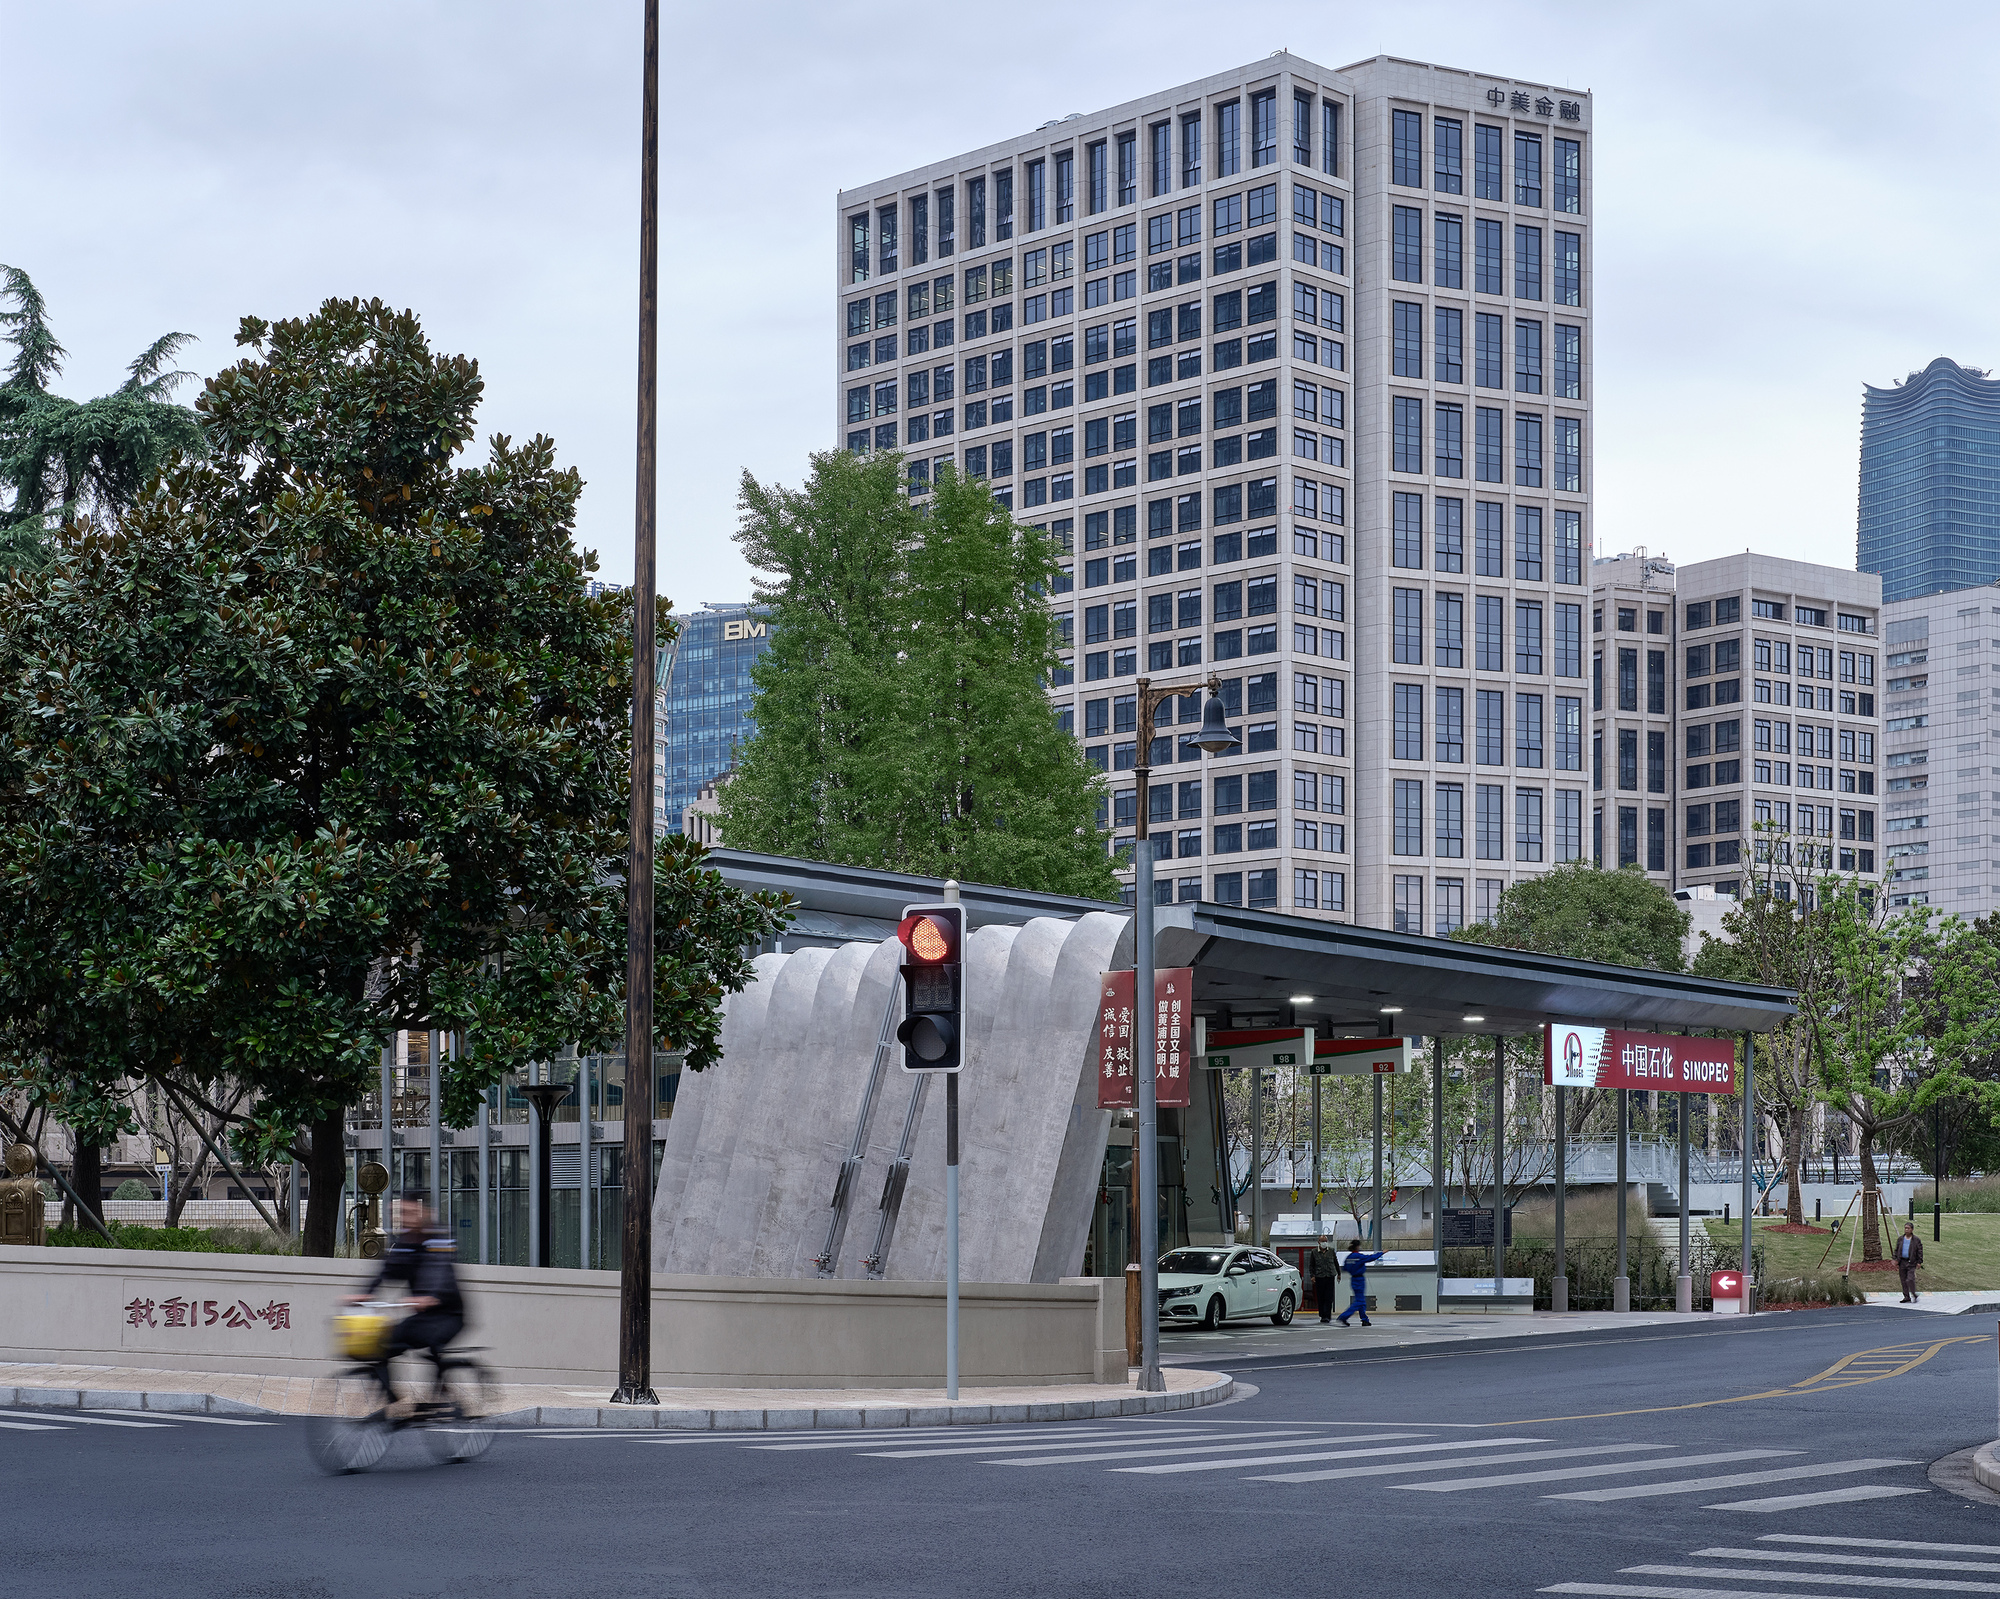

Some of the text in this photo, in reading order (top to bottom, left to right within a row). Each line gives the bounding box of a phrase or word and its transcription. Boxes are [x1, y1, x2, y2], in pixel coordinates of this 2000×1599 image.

[1487, 87, 1581, 122] 中美金融
[724, 619, 766, 641] BM
[1156, 1000, 1169, 1079] 做黄浦文明人
[1169, 999, 1182, 1079] 创全国文明城
[1214, 1057, 1224, 1066] 95
[1279, 1054, 1290, 1063] 98
[1315, 1065, 1325, 1073] 98
[1378, 1063, 1389, 1072] 92
[1621, 1043, 1674, 1079] 中国石化
[1683, 1060, 1729, 1083] SINOPEC
